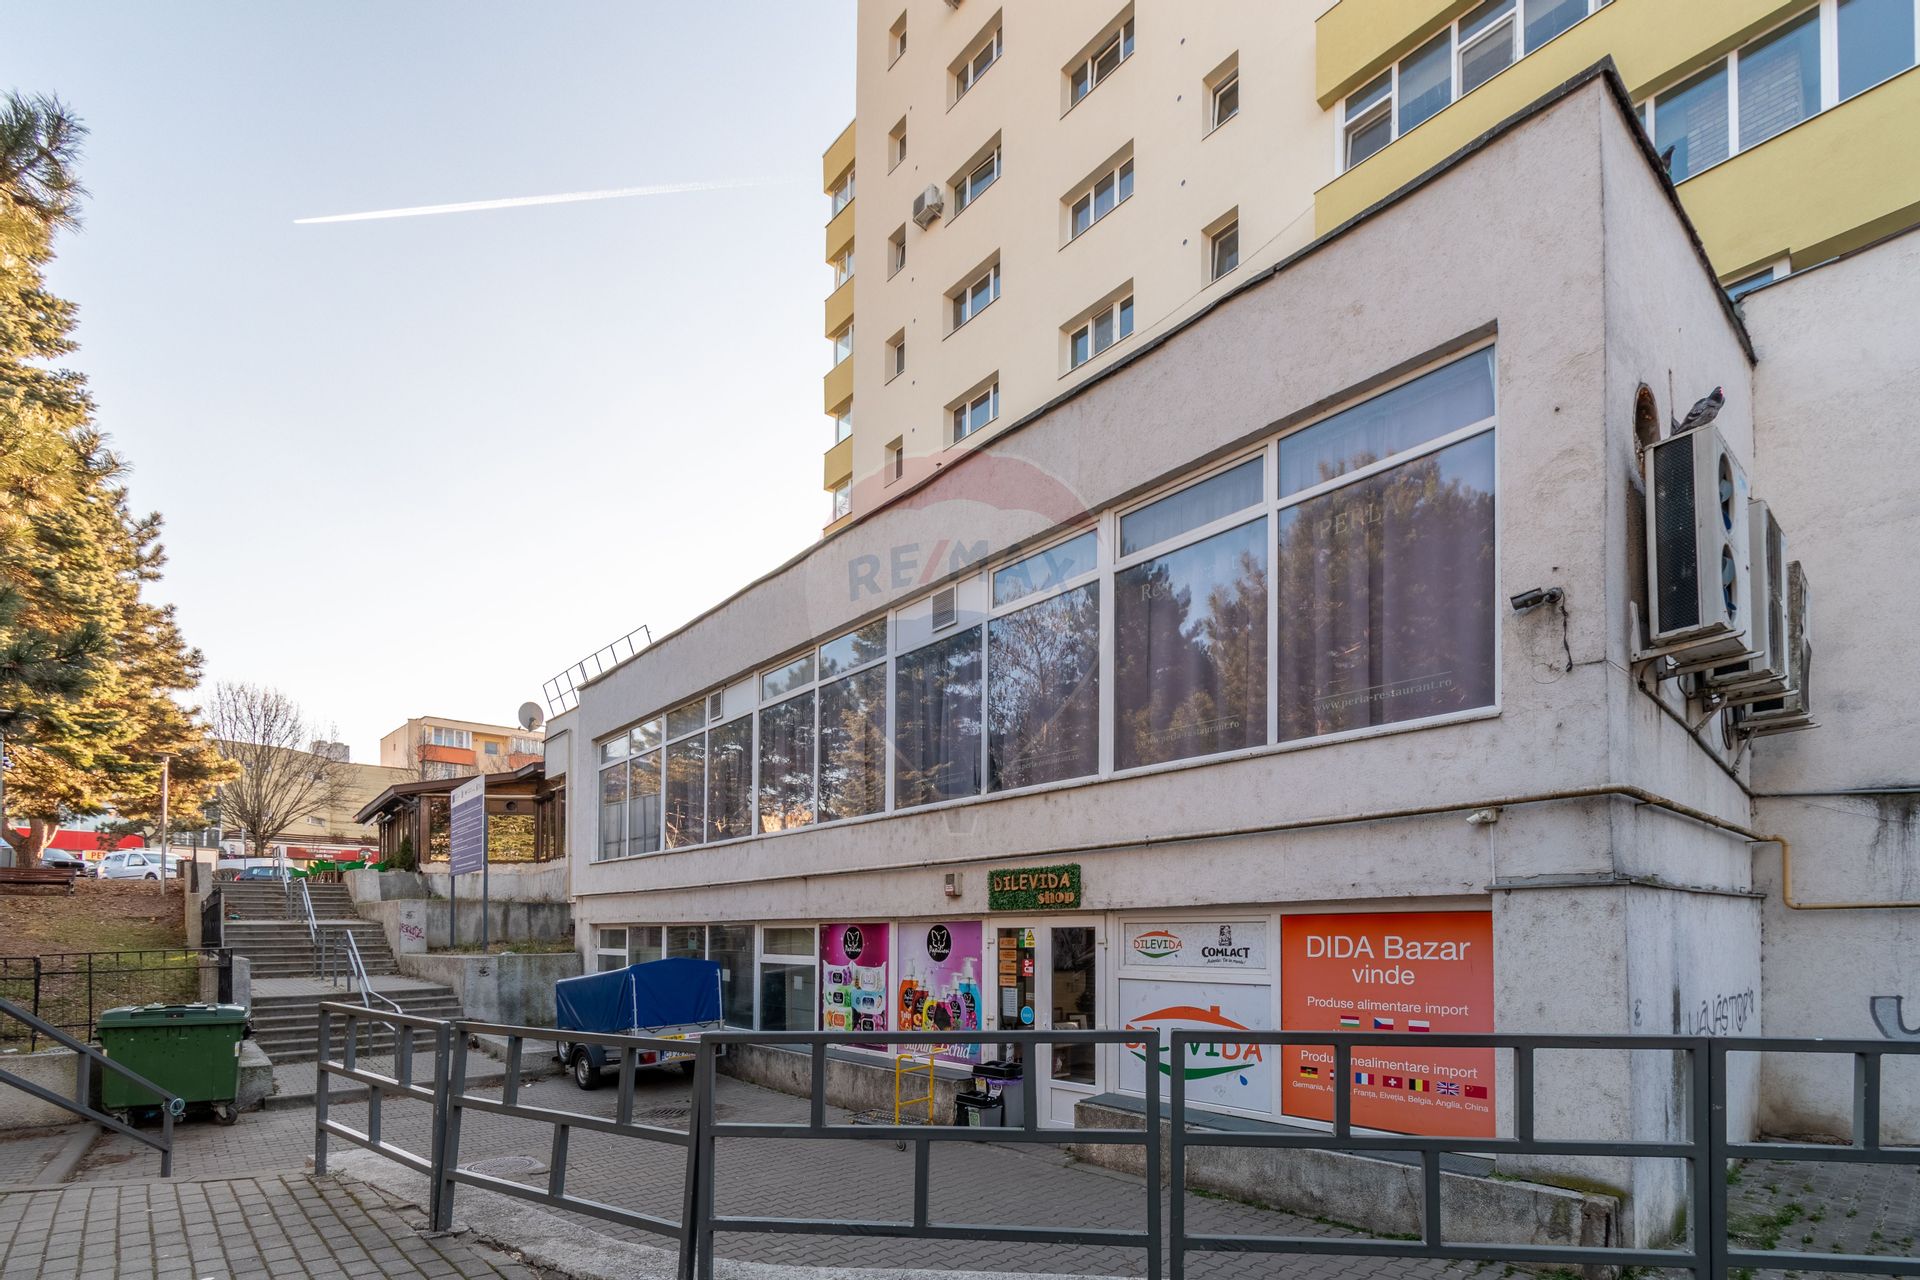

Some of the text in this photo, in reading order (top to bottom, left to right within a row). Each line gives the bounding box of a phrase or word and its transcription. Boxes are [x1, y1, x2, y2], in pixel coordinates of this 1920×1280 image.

[994, 873, 1071, 892] DILEVIDA
[1133, 938, 1183, 950] DILEVIDA
[1201, 946, 1250, 959] COMLACT
[1306, 935, 1472, 961] DIDA Bazar
[1352, 965, 1415, 985] vinde
[1307, 996, 1469, 1016] Produse alimentare import
[1301, 1050, 1478, 1079] Produ nealimentare import
[1292, 1080, 1325, 1092] Germania,
[1407, 1096, 1434, 1106] Belgia,
[1435, 1099, 1463, 1110] Anglia,
[1464, 1102, 1489, 1113] China
